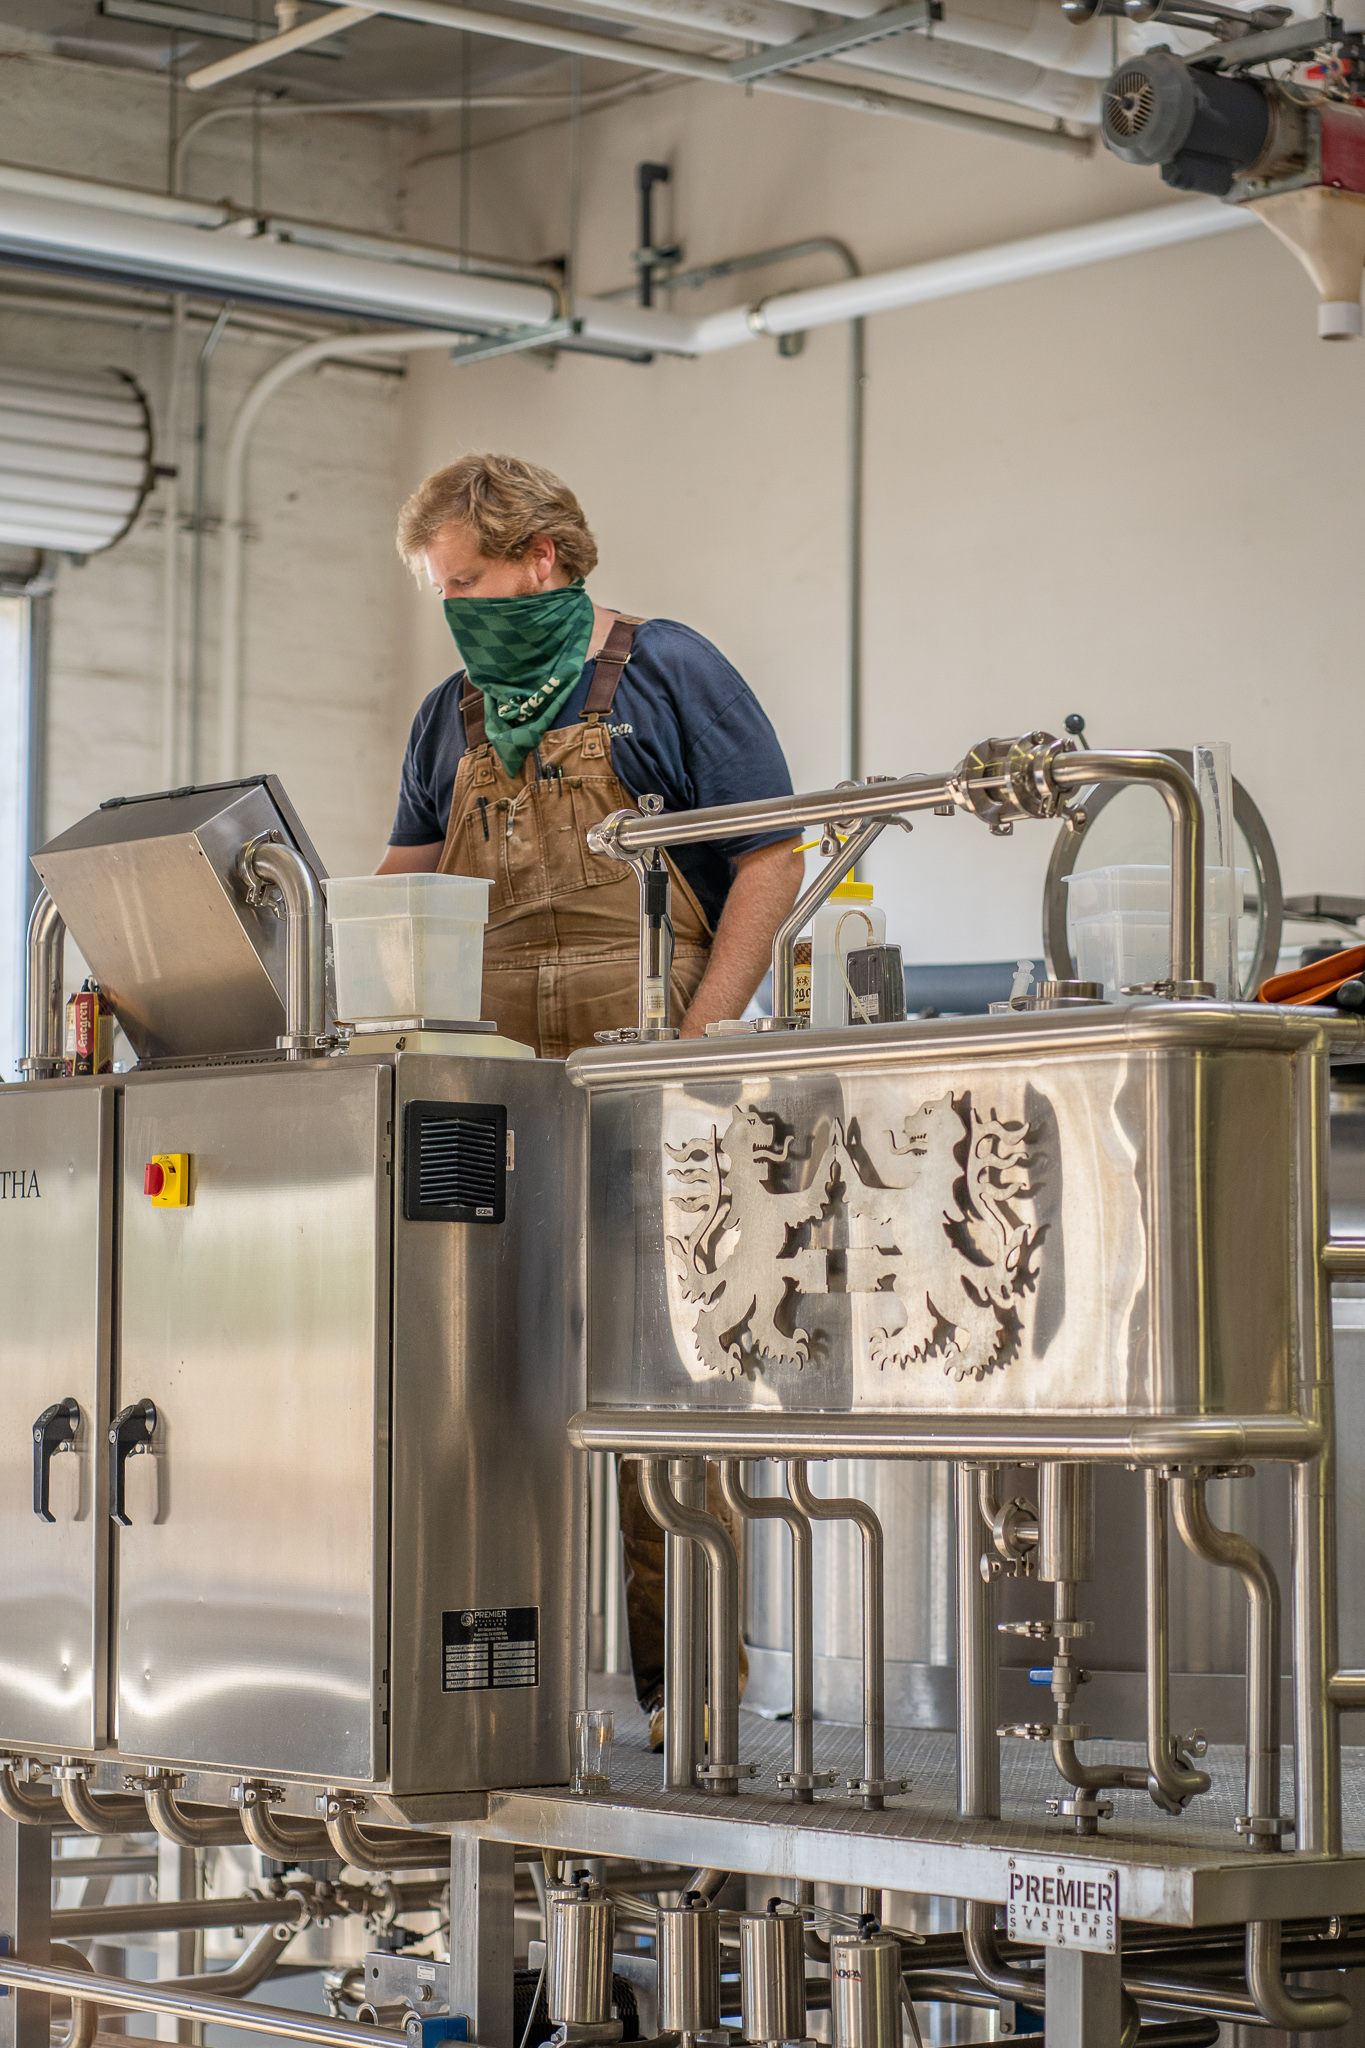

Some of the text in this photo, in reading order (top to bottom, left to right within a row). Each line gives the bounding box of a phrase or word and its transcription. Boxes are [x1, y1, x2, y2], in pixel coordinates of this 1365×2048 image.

[78, 1001, 92, 1048] Enegren
[0, 1169, 41, 1199] THA
[474, 1610, 507, 1619] PREMIER
[1010, 1873, 1112, 1912] PREMIER
[1009, 1904, 1113, 1926] STAINLESS
[1009, 1917, 1113, 1940] SYSTEMS
